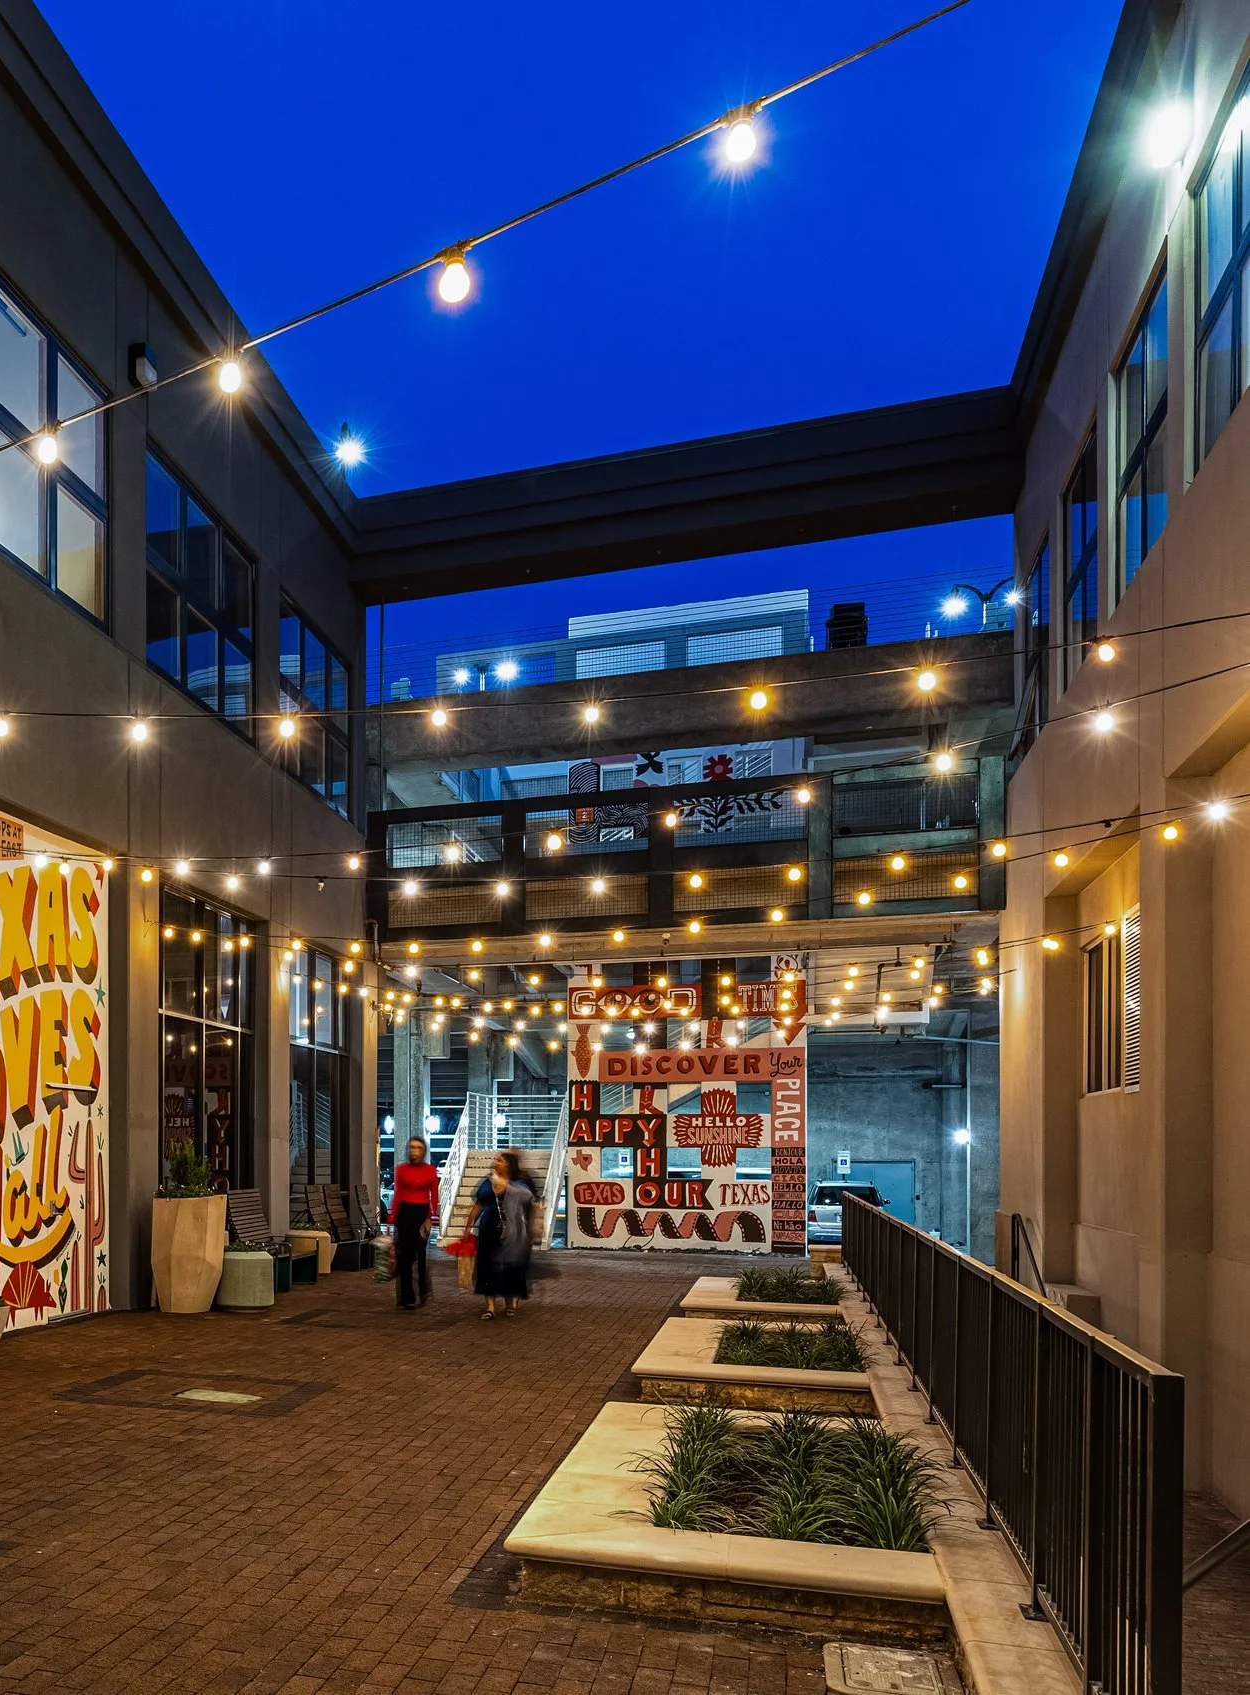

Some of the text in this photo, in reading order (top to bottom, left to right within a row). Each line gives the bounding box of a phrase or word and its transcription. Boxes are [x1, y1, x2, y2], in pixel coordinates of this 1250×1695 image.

[12, 827, 22, 839] AT
[1, 840, 22, 857] EAST
[607, 1052, 803, 1077] DISCOVER Your
[691, 1116, 747, 1127] HELLO
[687, 1126, 749, 1145] SUNSHINE
[774, 1157, 804, 1165] HOLA
[773, 1166, 804, 1174] HOWDY
[773, 1183, 804, 1192] HELLO
[717, 1183, 771, 1206] TEXAS
[773, 1201, 804, 1209] HALLO
